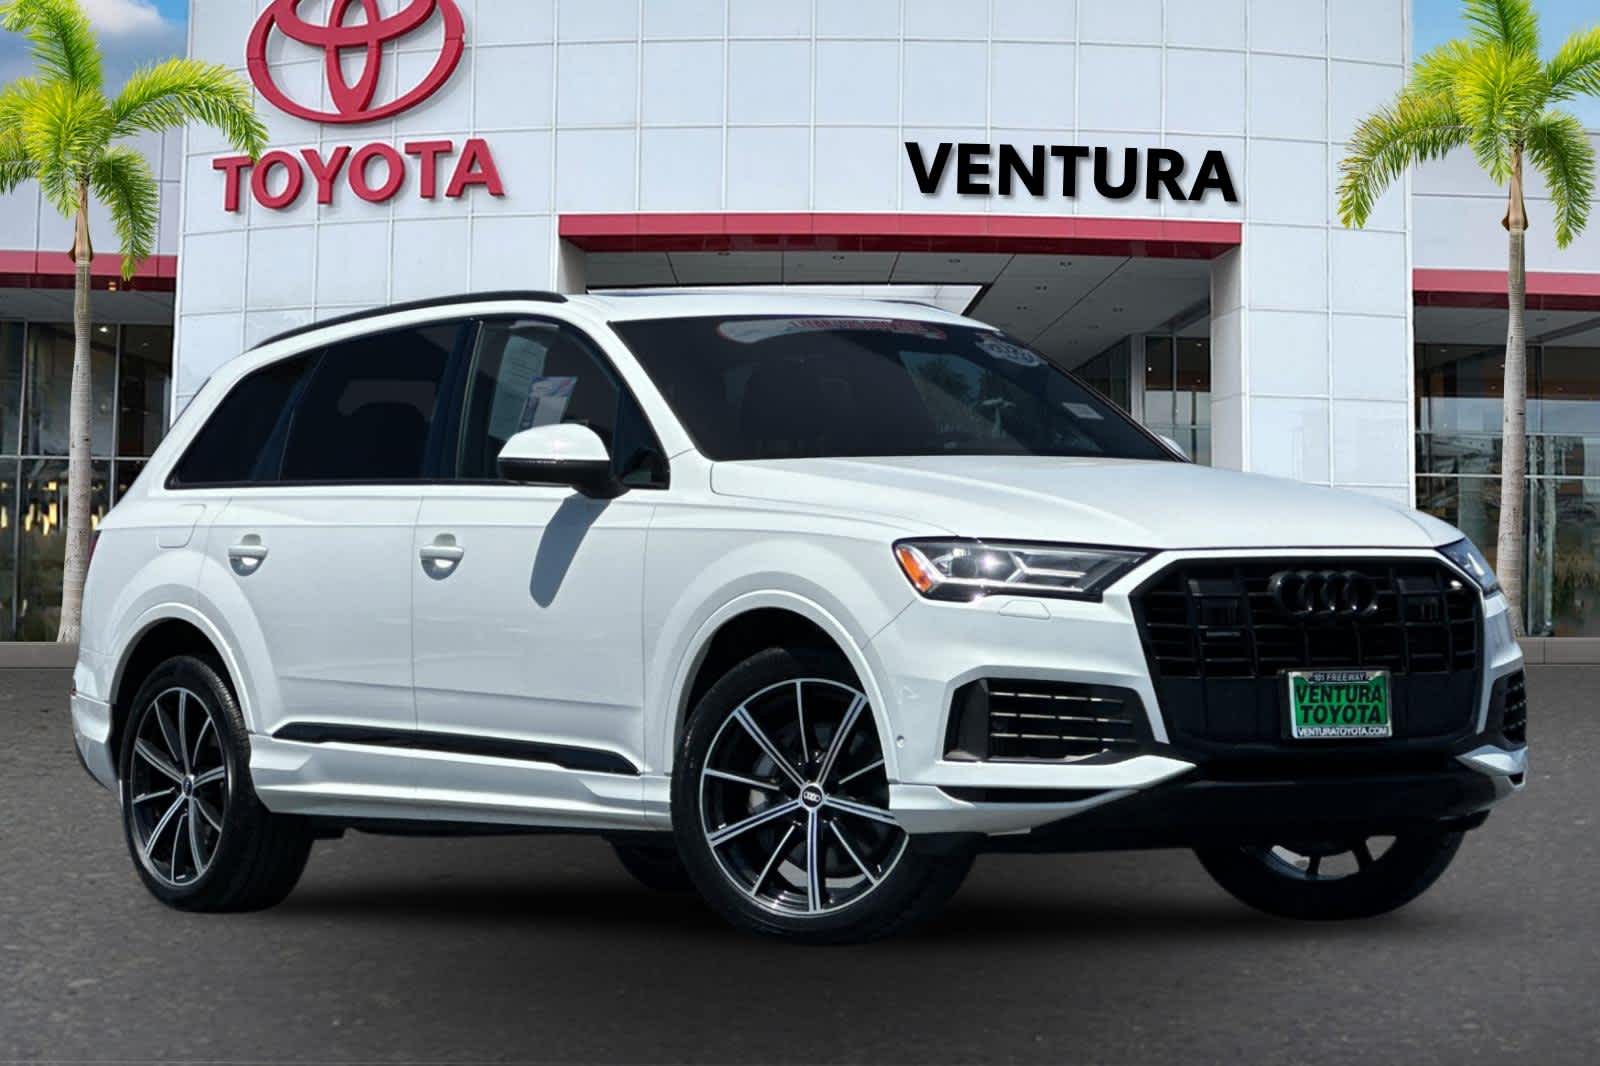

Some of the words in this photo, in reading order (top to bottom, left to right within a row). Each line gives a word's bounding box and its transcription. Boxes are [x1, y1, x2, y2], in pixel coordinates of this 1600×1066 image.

[213, 139, 504, 212] TOYOTA
[905, 142, 1238, 202] VENTURA
[1326, 672, 1365, 681] FREEWAY
[1296, 685, 1382, 703] VENTURA
[1300, 704, 1381, 724] TOYOTA
[1298, 727, 1387, 737] VENTURATOYOTA.COM
